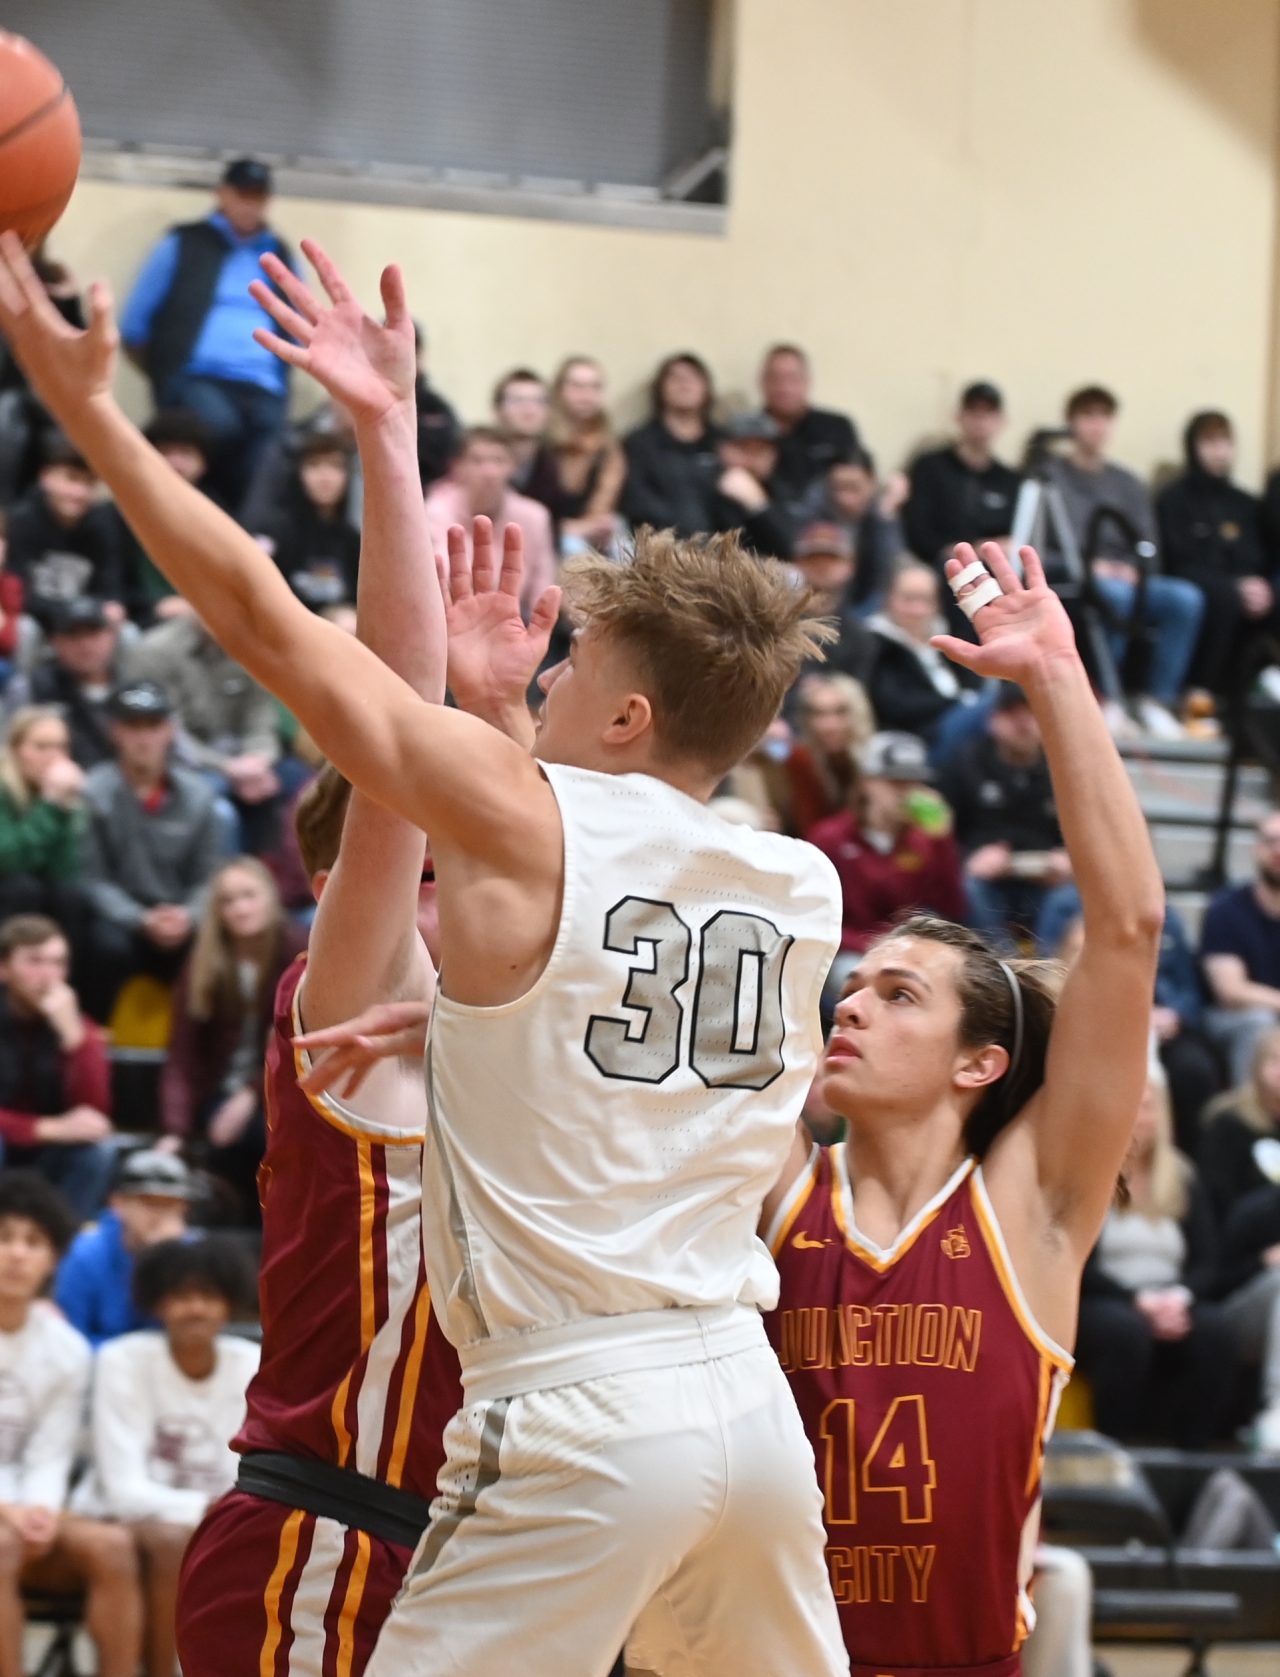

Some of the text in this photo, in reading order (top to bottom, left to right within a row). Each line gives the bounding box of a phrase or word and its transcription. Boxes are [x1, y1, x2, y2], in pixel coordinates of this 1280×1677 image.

[583, 895, 795, 1092] 30
[820, 1394, 937, 1525] 14
[824, 1545, 937, 1605] CITY
